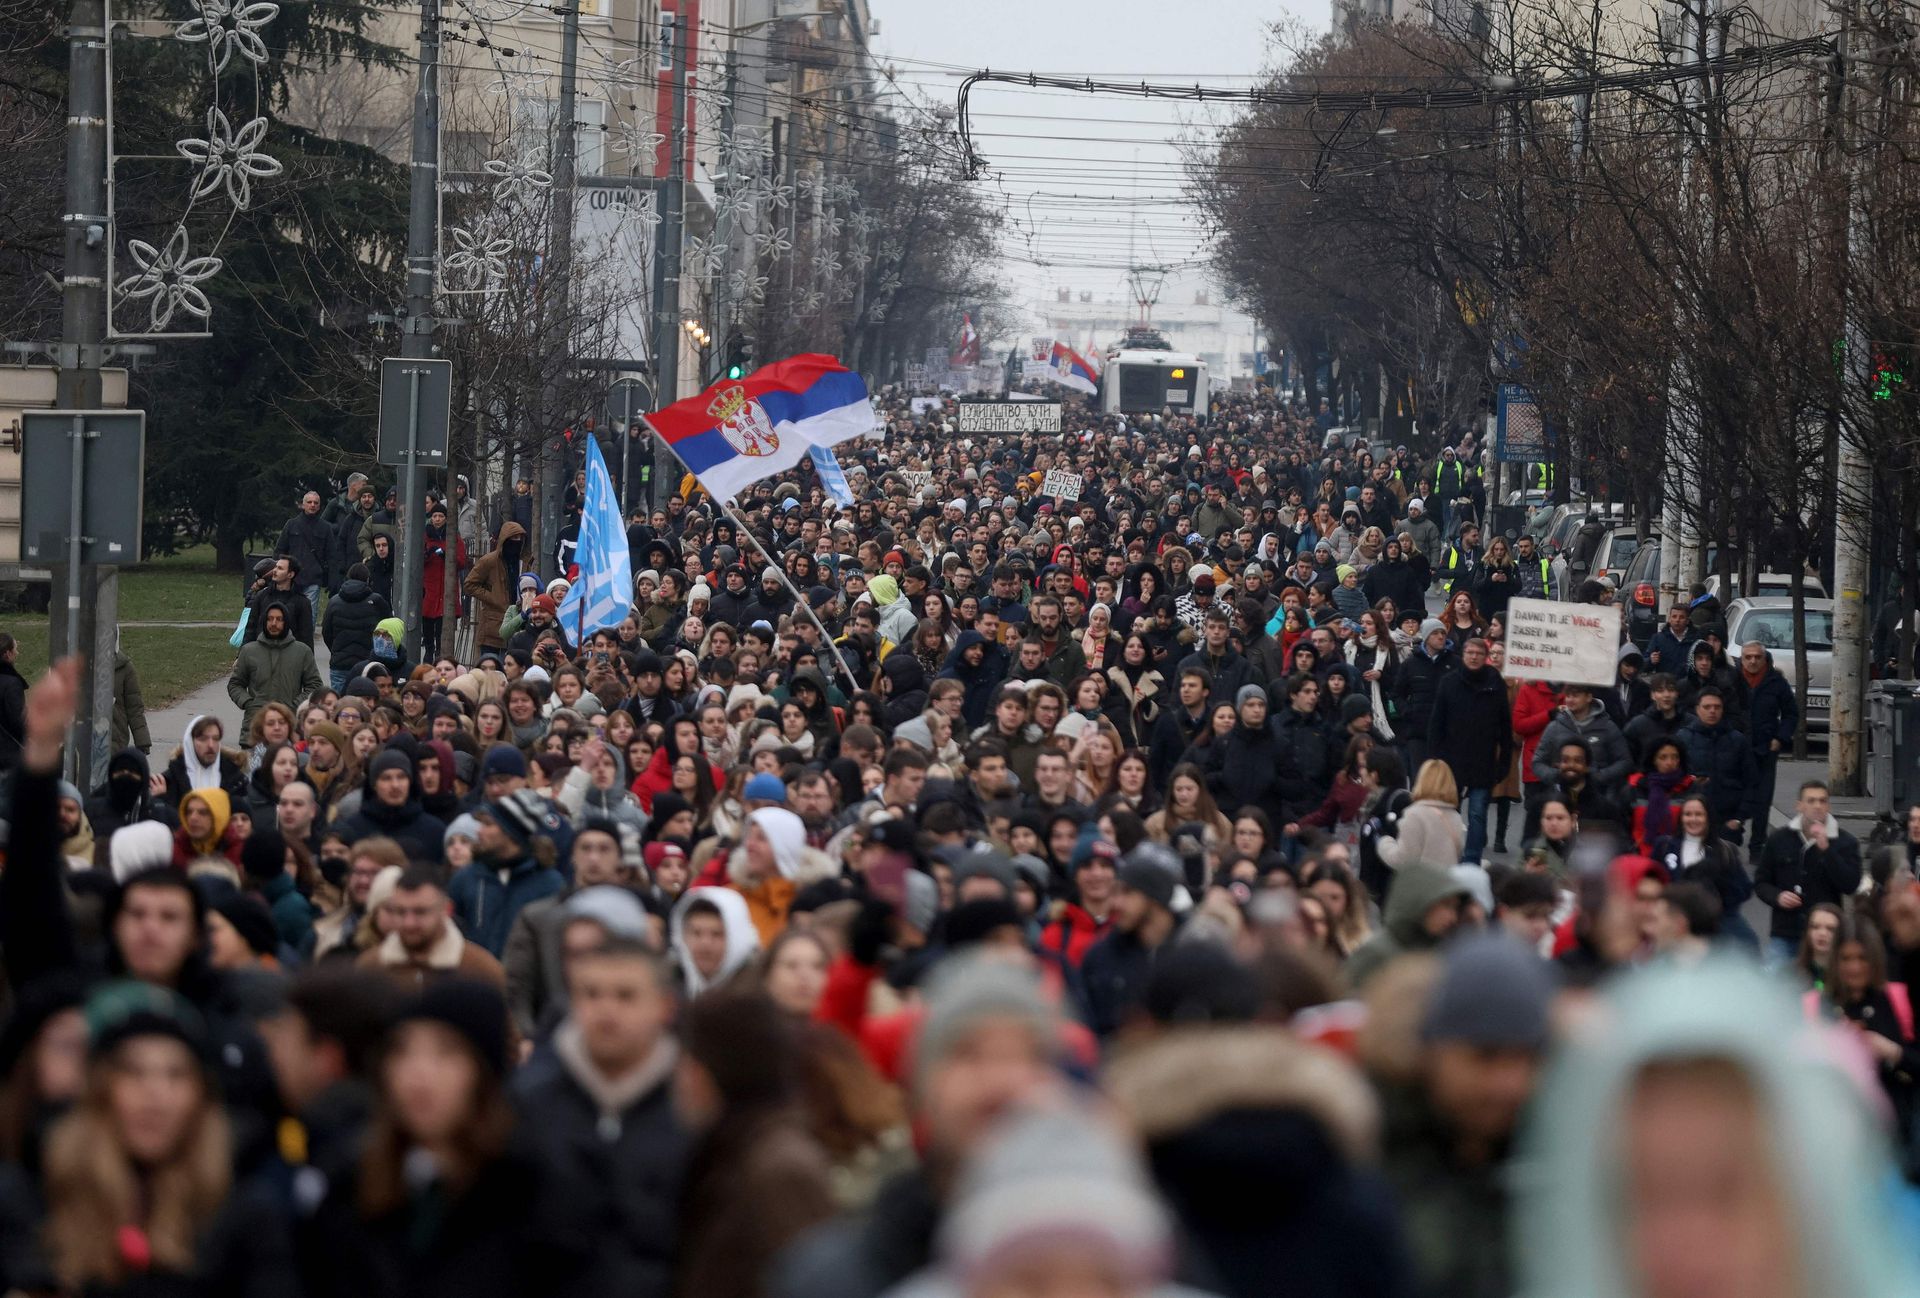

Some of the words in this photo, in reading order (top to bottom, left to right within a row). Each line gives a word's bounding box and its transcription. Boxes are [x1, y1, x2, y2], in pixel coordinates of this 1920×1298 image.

[960, 418, 1010, 431] СТУДЕНТИ
[1013, 418, 1026, 430] СУ
[1048, 471, 1080, 488] SISTEM
[1046, 483, 1057, 493] TE
[1514, 609, 1546, 622] DAVNO
[1548, 612, 1557, 623] TI
[1558, 614, 1571, 625] JE
[1545, 628, 1558, 639] NA
